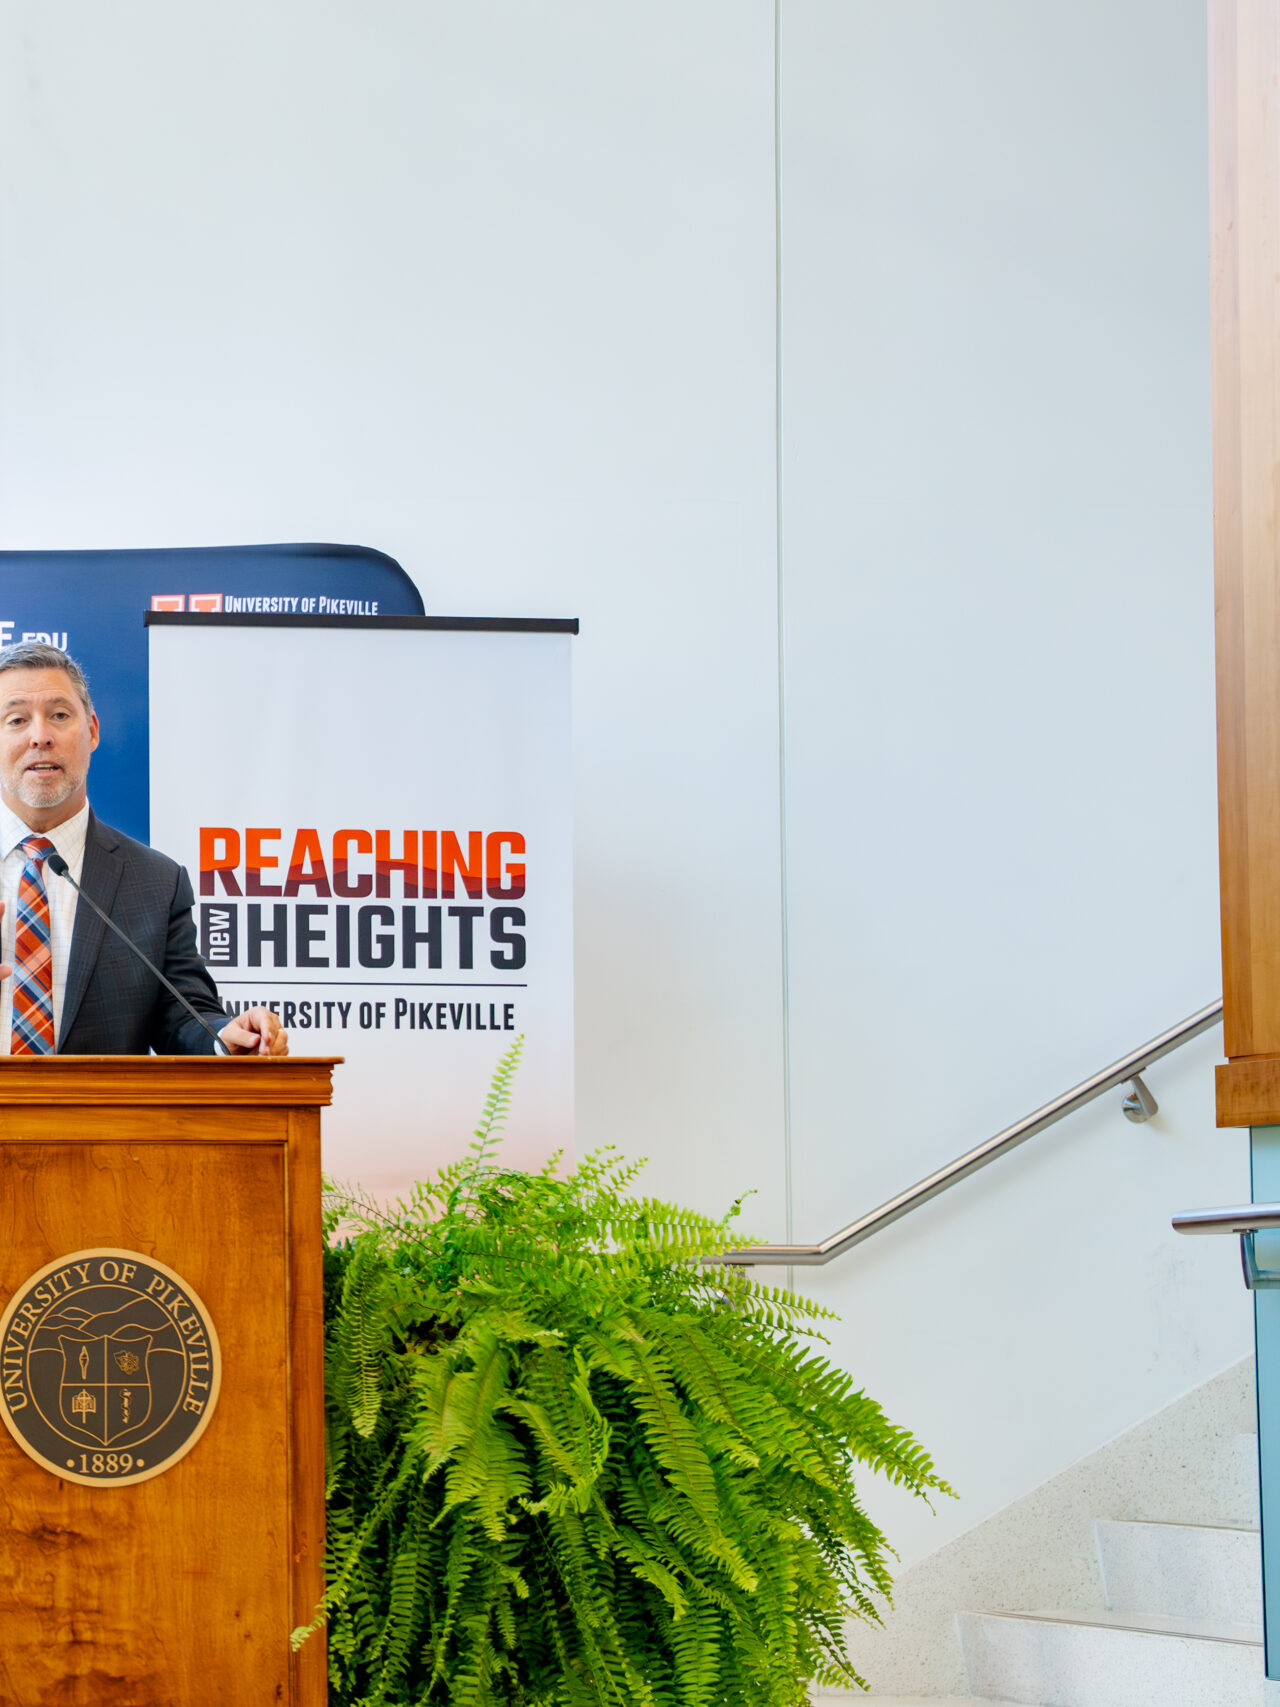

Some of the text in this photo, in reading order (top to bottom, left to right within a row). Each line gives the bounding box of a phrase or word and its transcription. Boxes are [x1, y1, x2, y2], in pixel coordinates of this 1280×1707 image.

[224, 595, 299, 613] UNIVERSITY
[301, 597, 316, 613] OF
[318, 596, 378, 616] PIKEVILLE
[199, 827, 526, 900] REACHING
[208, 903, 527, 970] new HEIGHTS
[359, 1001, 386, 1030] OF
[394, 997, 515, 1031] PIKEVILLE
[4, 1260, 210, 1416] UNIVERSITY OF PIKEVILLE
[78, 1453, 134, 1474] 1889
